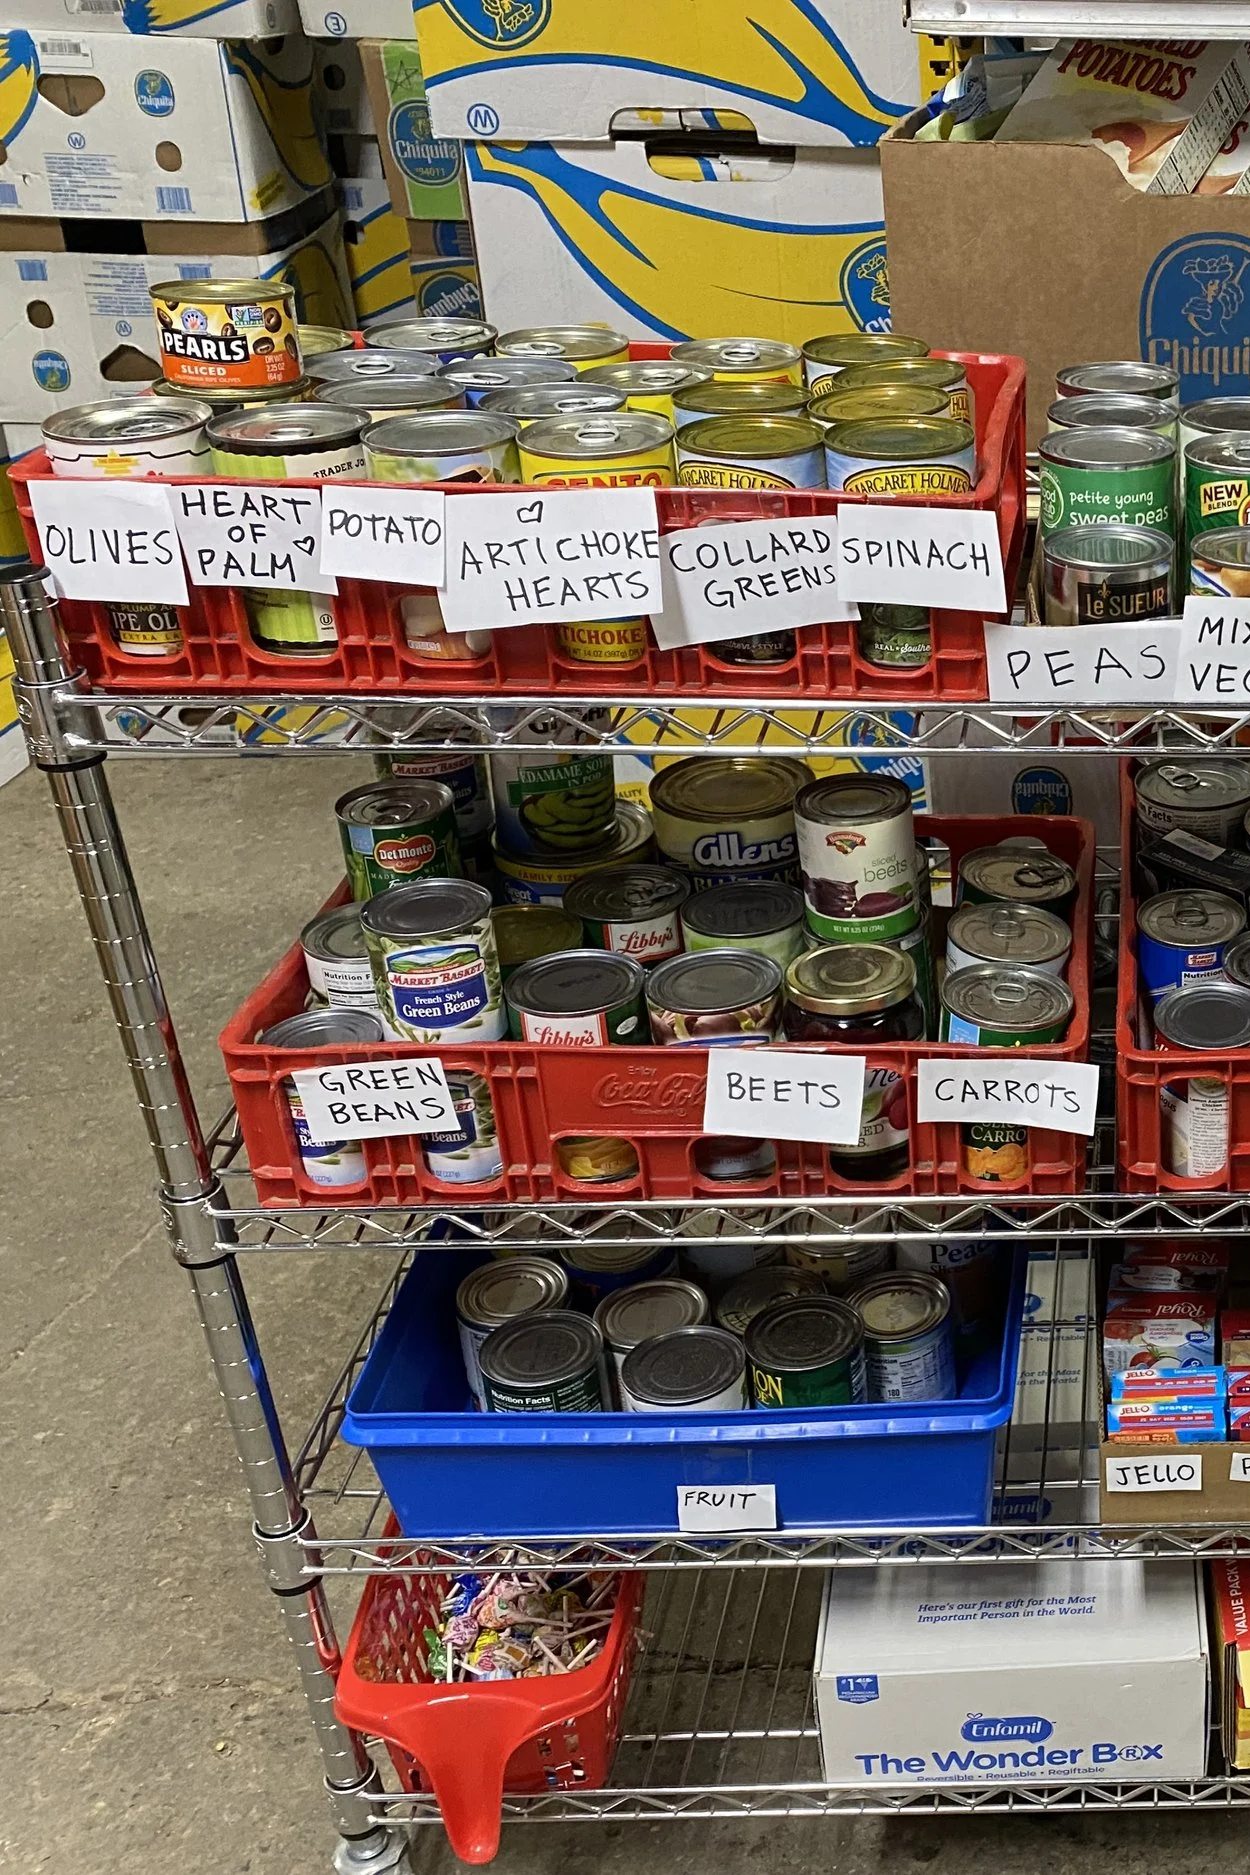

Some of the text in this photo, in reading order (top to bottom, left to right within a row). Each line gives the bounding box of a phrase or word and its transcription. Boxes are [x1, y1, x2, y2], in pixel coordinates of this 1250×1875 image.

[1057, 39, 1197, 101] POTATOES
[138, 94, 174, 109] Chiquita
[395, 140, 458, 165] Chiquita
[164, 332, 246, 361] PEARLS
[181, 364, 226, 376] SLICED
[313, 462, 350, 478] TRADER
[849, 471, 969, 493] MARGARET HOLMES
[1070, 491, 1111, 506] petite
[1115, 491, 1153, 512] young
[1203, 484, 1243, 502] NEW
[181, 489, 311, 525] HEART
[1070, 505, 1168, 526] sweet peas
[1208, 501, 1238, 511] BLENDS
[228, 523, 266, 544] OF
[329, 509, 442, 545] POTATO
[45, 525, 173, 565] OLIVES
[460, 530, 659, 580] ARTICHOKE
[669, 529, 831, 573] COLLARD
[198, 549, 296, 583] PALM
[842, 537, 990, 577] SPINACH
[504, 570, 649, 611] HEARTS
[703, 564, 836, 609] GREENS
[1085, 587, 1165, 617] Le SUEUR
[874, 643, 895, 651] REAL
[1007, 645, 1166, 690] PEAS
[394, 762, 436, 776] MARKET
[378, 843, 433, 861] Del Monte
[871, 854, 896, 868] sliced
[863, 859, 907, 883] beets
[619, 929, 674, 953] Libby's
[324, 971, 363, 982] Nutrition
[390, 963, 484, 987] MARKET BASKET
[402, 995, 481, 1019] Green Beans
[415, 990, 464, 1006] French Style
[534, 1026, 595, 1046] Libby's
[319, 1063, 442, 1095] GREEN
[593, 1072, 708, 1108] Coca-Col
[727, 1072, 841, 1109] BEETS
[935, 1078, 1080, 1113] CARROTS
[328, 1097, 445, 1124] BEANS
[431, 1130, 468, 1144] Beans
[971, 1126, 1027, 1142] CARRO
[1156, 1303, 1206, 1321] Royal
[1125, 1370, 1155, 1379] JELL-O
[491, 1390, 551, 1405] Nutrition Facts
[1120, 1405, 1151, 1415] JELL-O
[1115, 1464, 1195, 1485] JELLO
[685, 1491, 756, 1509] FRUIT
[1230, 1570, 1244, 1602] PACK
[918, 1595, 1097, 1612] Here's our first gift for the Most
[918, 1606, 1096, 1624] Important Person in the World.
[1235, 1604, 1249, 1635] VALUE
[972, 1720, 1042, 1737] Enfamil
[854, 1753, 925, 1777] The
[931, 1745, 1084, 1773] Wonder
[986, 1766, 1106, 1779] Reusable Regiftable
